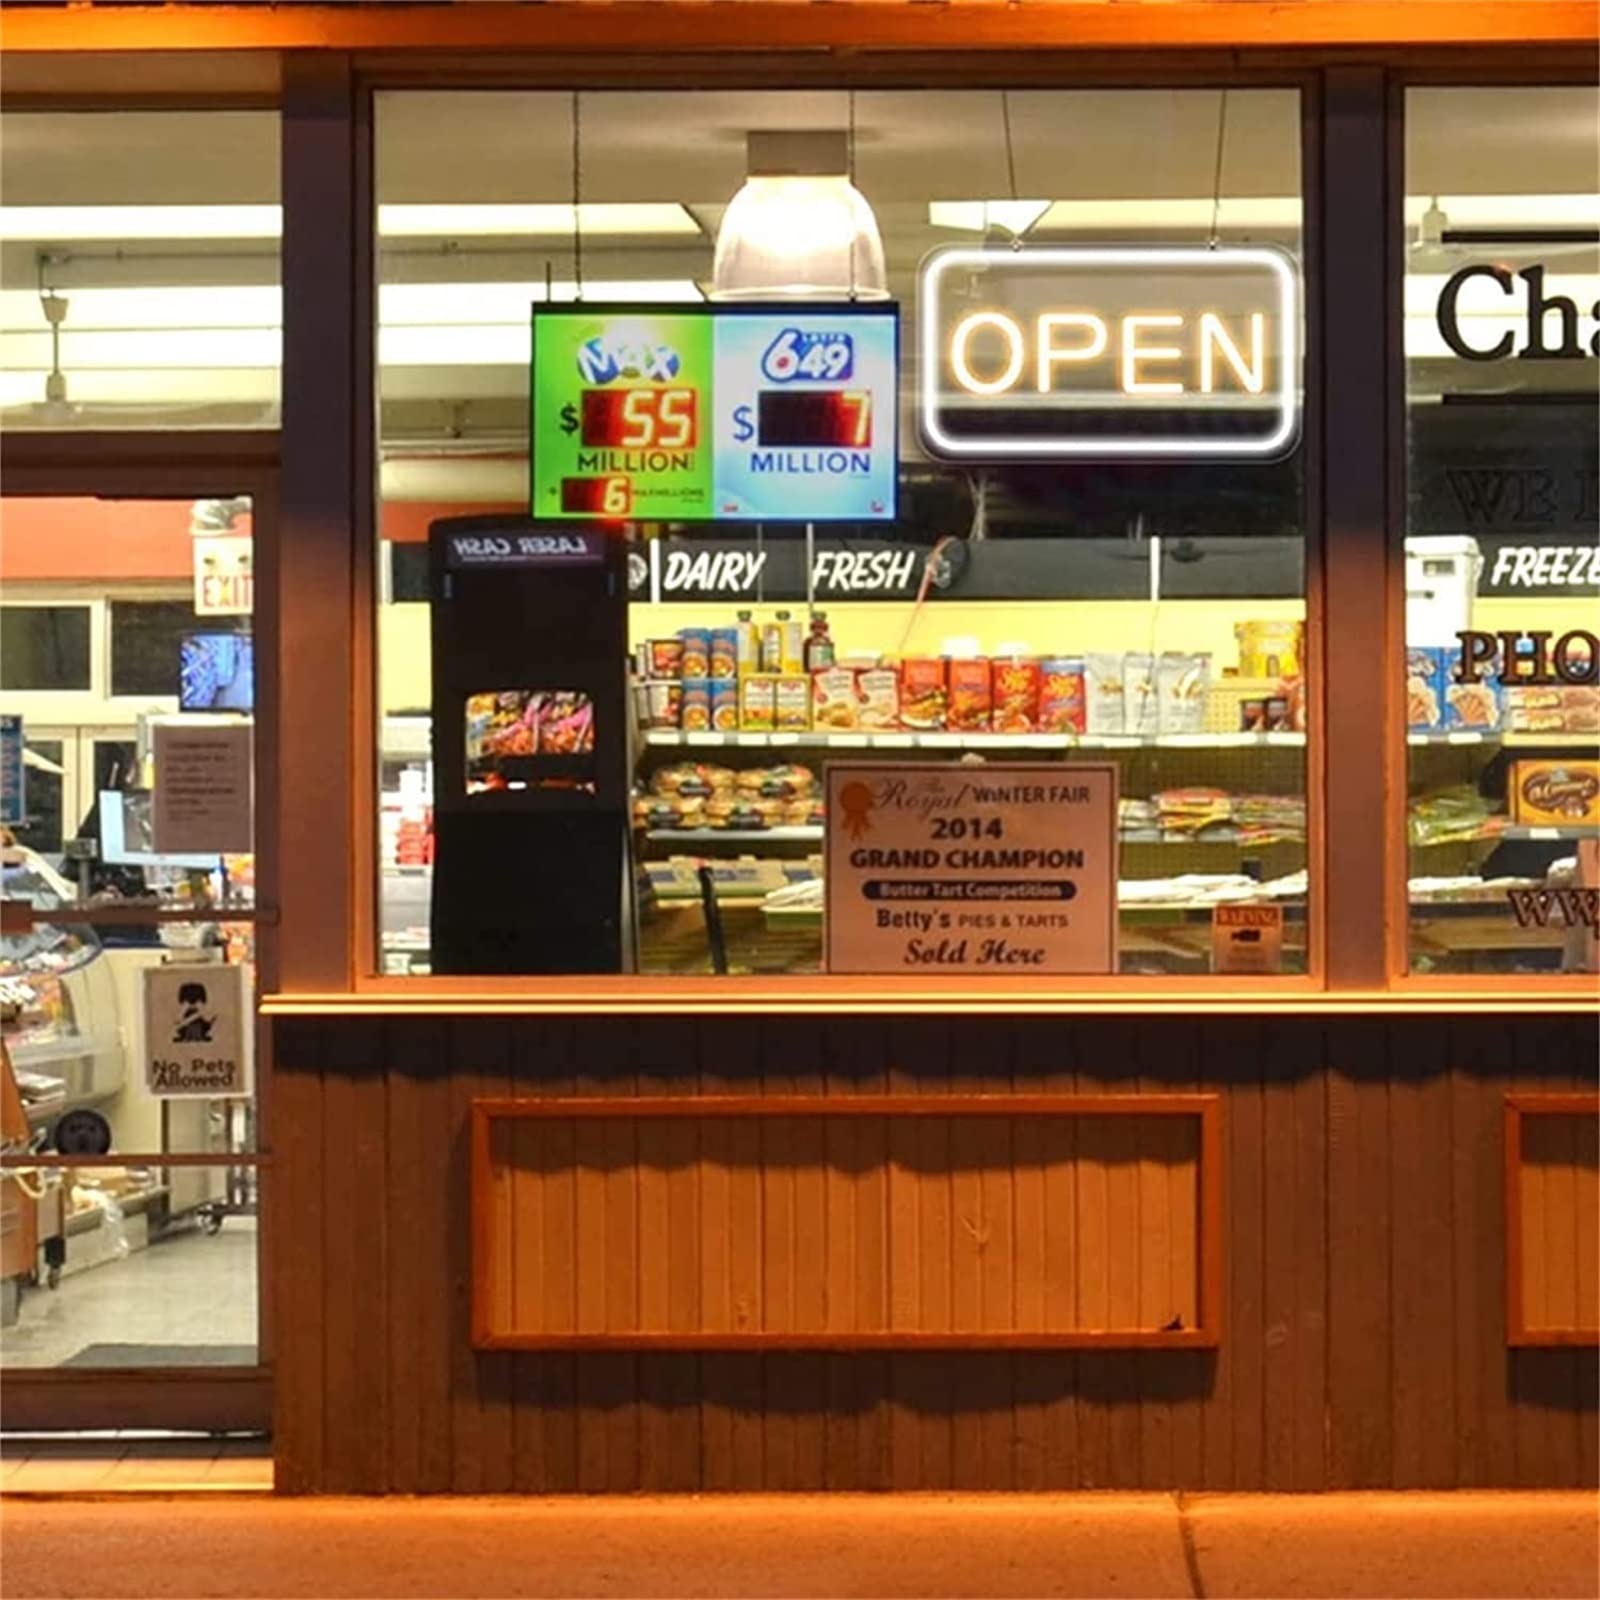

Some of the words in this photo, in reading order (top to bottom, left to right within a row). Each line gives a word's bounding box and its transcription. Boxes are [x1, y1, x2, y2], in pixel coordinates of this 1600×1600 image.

[1436, 264, 1600, 361] Ch
[950, 312, 1266, 395] OPEN
[560, 403, 579, 436] $
[622, 391, 692, 447] 55
[733, 406, 754, 443] $
[842, 391, 870, 444] 7
[577, 453, 689, 473] MILLION
[750, 452, 871, 473] MILLION
[603, 477, 628, 512] 6
[664, 551, 766, 592] DAIRY
[811, 551, 915, 592] FRESH
[203, 575, 252, 608] EXIT
[876, 777, 971, 820] Royal
[1050, 786, 1091, 803] FAIR
[931, 818, 1003, 840] 2014
[849, 849, 939, 868] GRAND
[945, 849, 1084, 868] CHAMPION
[880, 883, 931, 897] Butter
[933, 883, 963, 897] Tart
[965, 883, 1062, 900] Competition
[876, 908, 951, 932] Betty's
[958, 914, 995, 927] PIES
[1001, 914, 1012, 927] &
[1017, 914, 1069, 928] TARTS
[903, 939, 968, 965] Sold
[975, 940, 1046, 965] Here
[152, 1060, 181, 1074] No
[192, 1059, 236, 1073] Pets
[154, 1073, 233, 1088] Allowed
